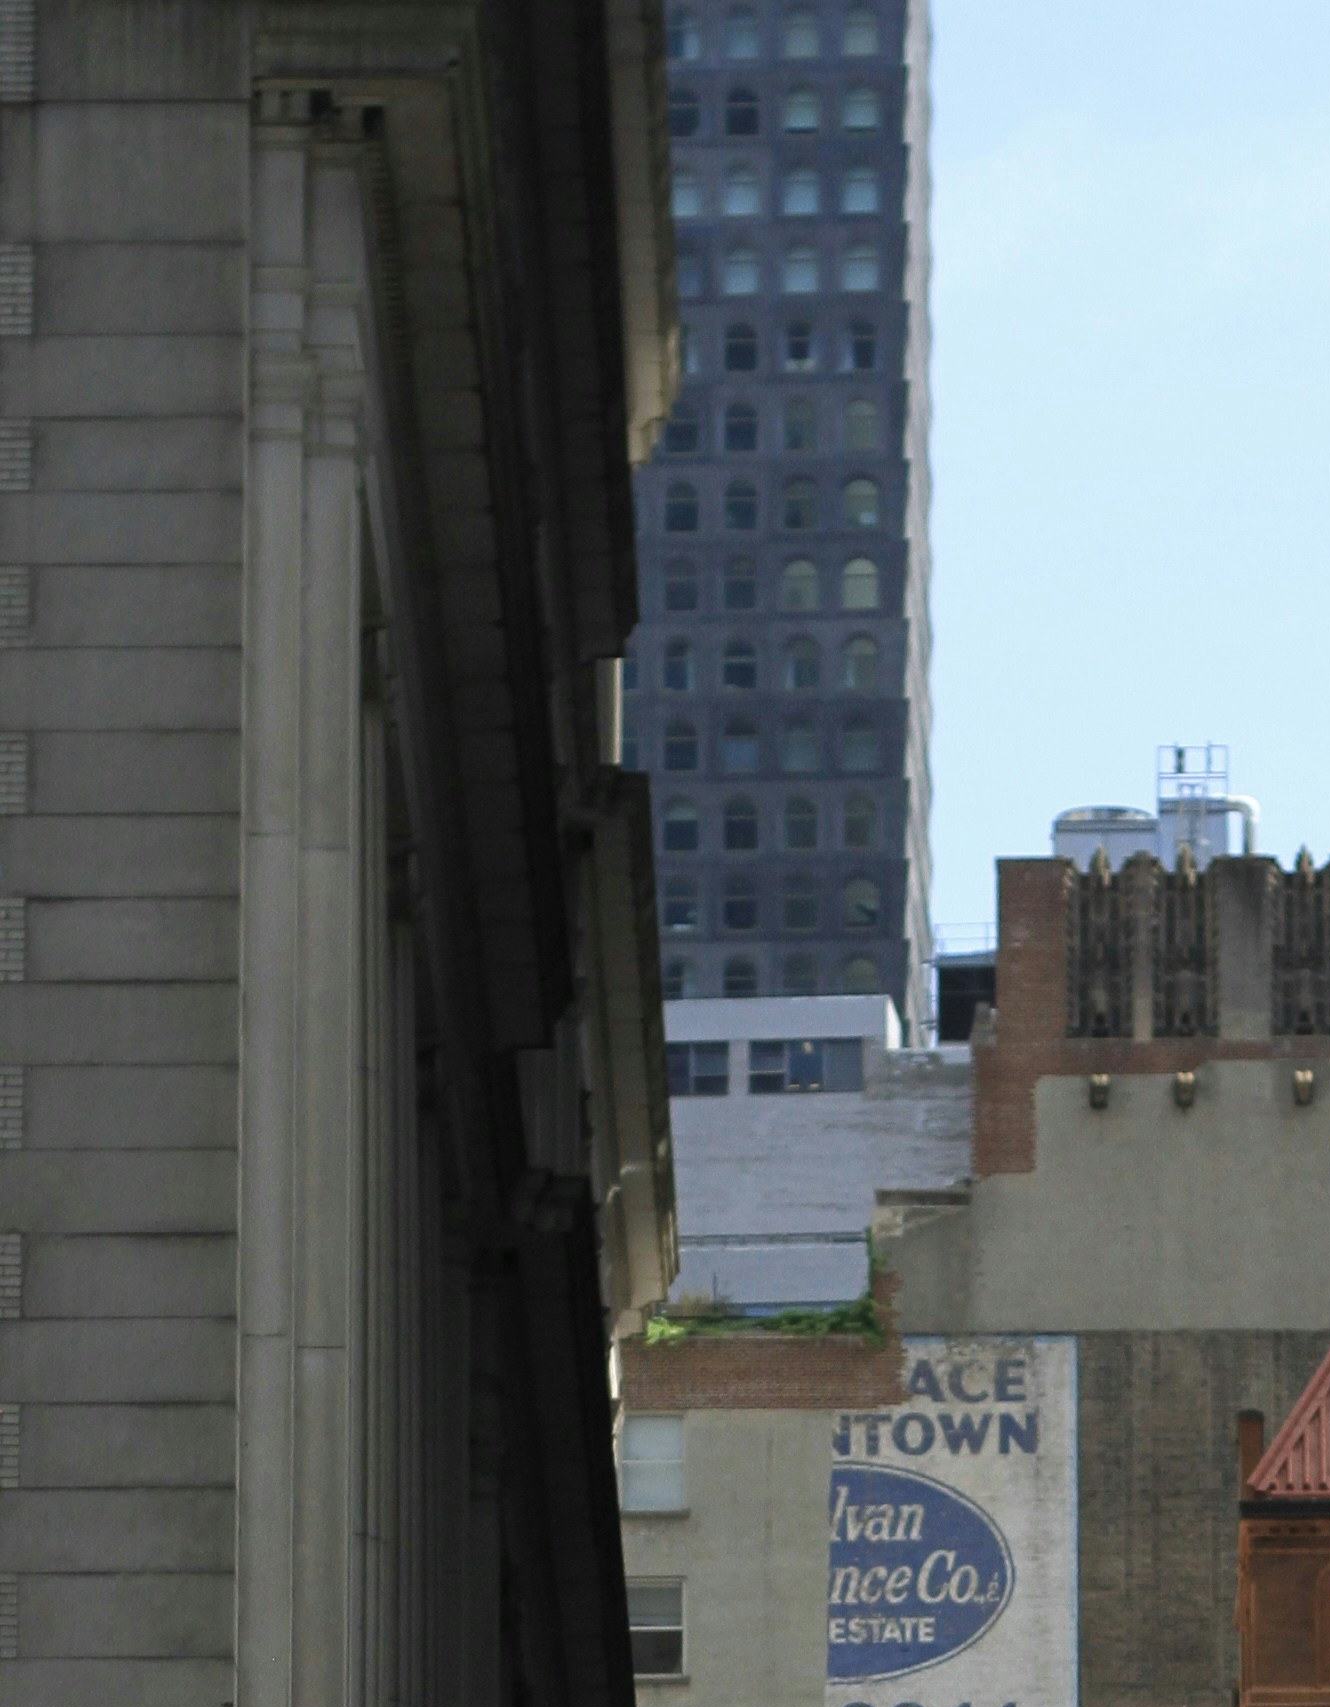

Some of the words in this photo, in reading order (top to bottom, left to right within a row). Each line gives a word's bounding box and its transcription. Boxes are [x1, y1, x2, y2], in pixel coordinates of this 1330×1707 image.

[907, 1358, 1028, 1403] ACE
[830, 1564, 914, 1605] nce
[829, 1615, 936, 1643] ESTATE
